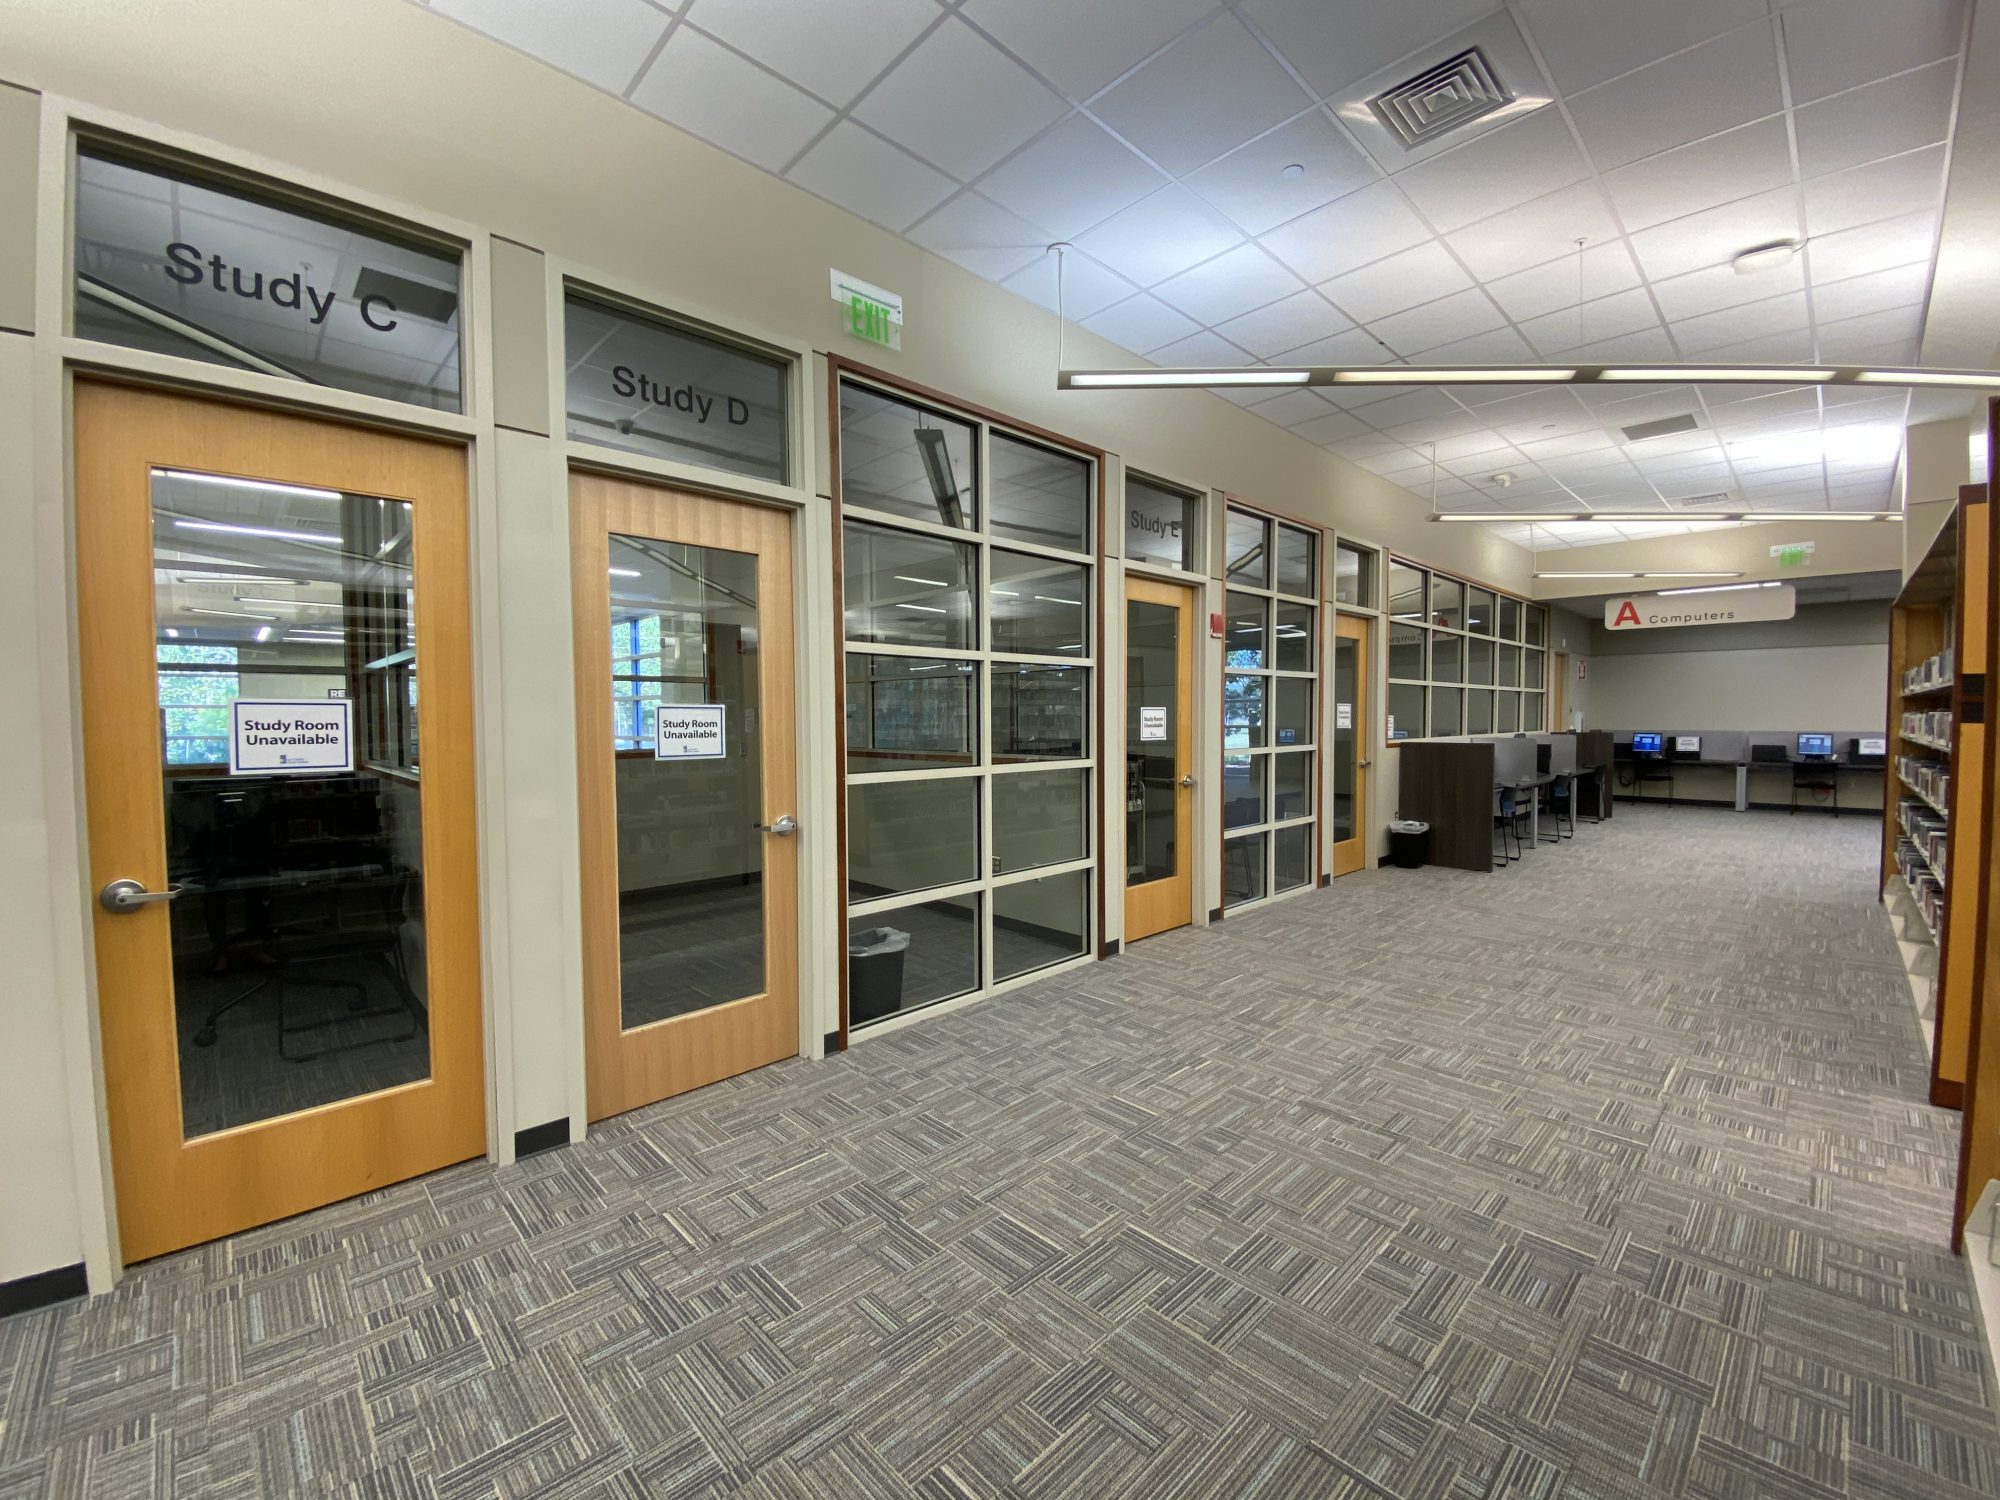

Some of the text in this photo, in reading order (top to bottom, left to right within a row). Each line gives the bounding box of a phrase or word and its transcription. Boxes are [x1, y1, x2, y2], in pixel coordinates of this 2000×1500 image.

[165, 242, 397, 332] Study C
[851, 295, 890, 344] EXIT
[612, 365, 749, 425] Study D
[1131, 510, 1179, 539] Study E
[1613, 601, 1735, 627] A Computers
[244, 719, 339, 733] Study Room
[662, 719, 718, 730] Study Room
[663, 730, 718, 739] Unavailable
[246, 734, 339, 745] Unavailable
